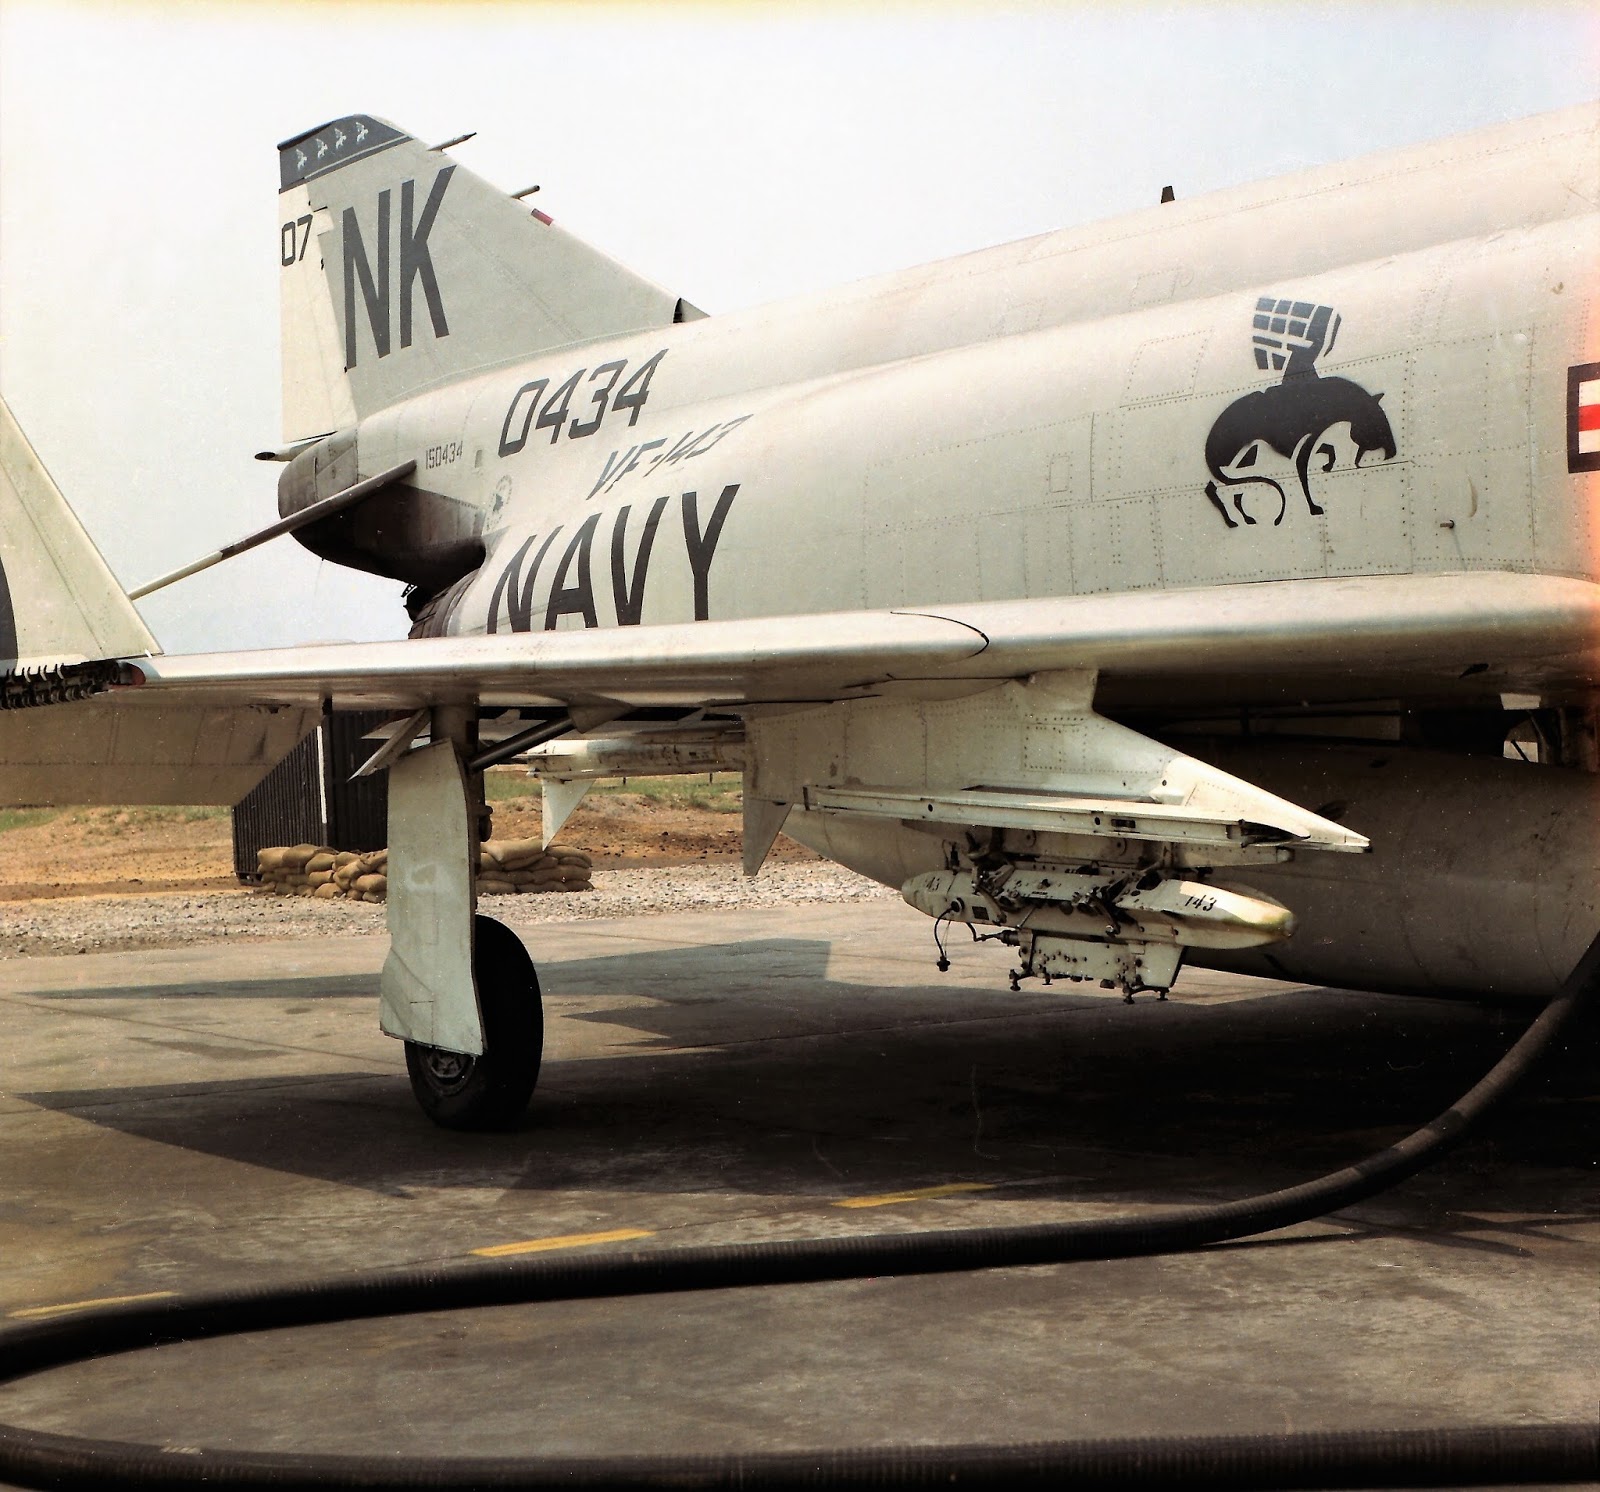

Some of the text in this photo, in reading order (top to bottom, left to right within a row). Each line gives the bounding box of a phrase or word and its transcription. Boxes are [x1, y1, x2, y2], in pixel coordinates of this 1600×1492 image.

[281, 214, 313, 266] 07
[342, 165, 457, 371] NK
[498, 348, 669, 458] 0434
[425, 440, 463, 470] 150434
[586, 414, 754, 500] VF-143
[487, 484, 741, 634] NAVY
[1184, 894, 1217, 911] 143
